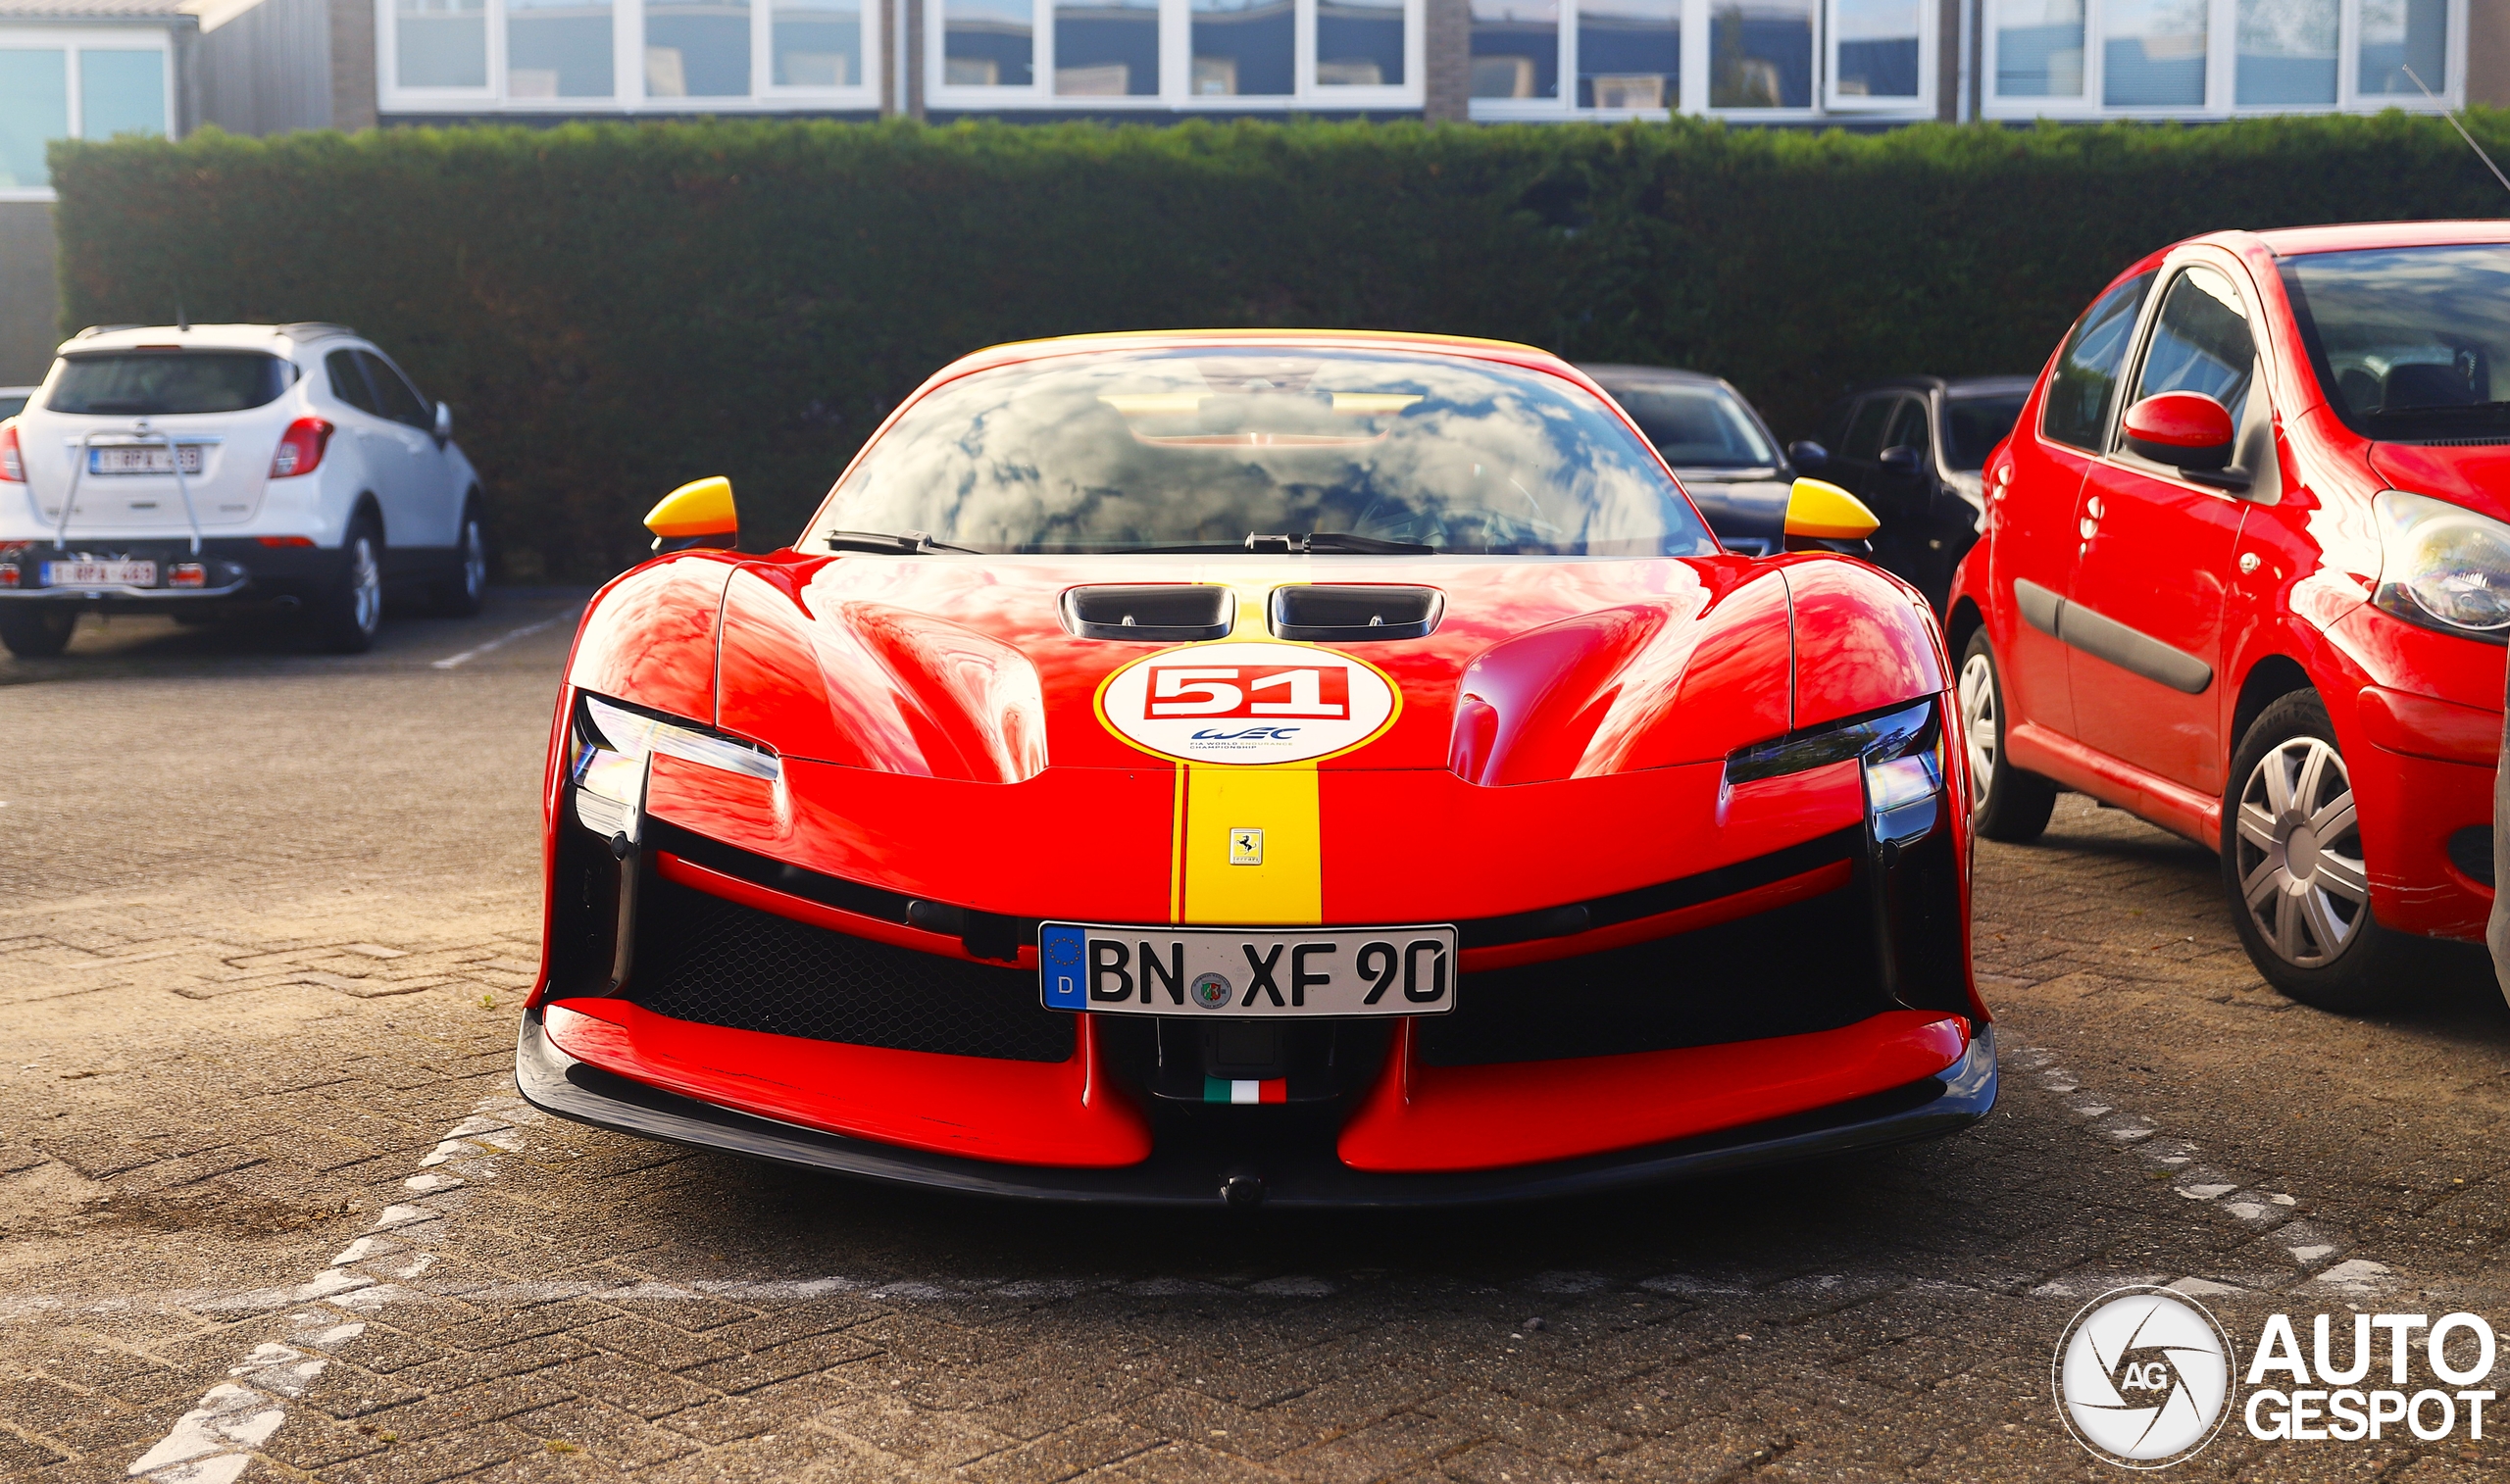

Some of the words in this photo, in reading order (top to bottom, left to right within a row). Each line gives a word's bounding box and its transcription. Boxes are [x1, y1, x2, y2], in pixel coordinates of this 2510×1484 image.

[1151, 668, 1344, 717] 51
[1190, 727, 1302, 740] WEC
[1058, 976, 1074, 995] D
[1088, 939, 1184, 1006] BN
[1240, 942, 1337, 1008] XF
[1356, 940, 1447, 1005] 90
